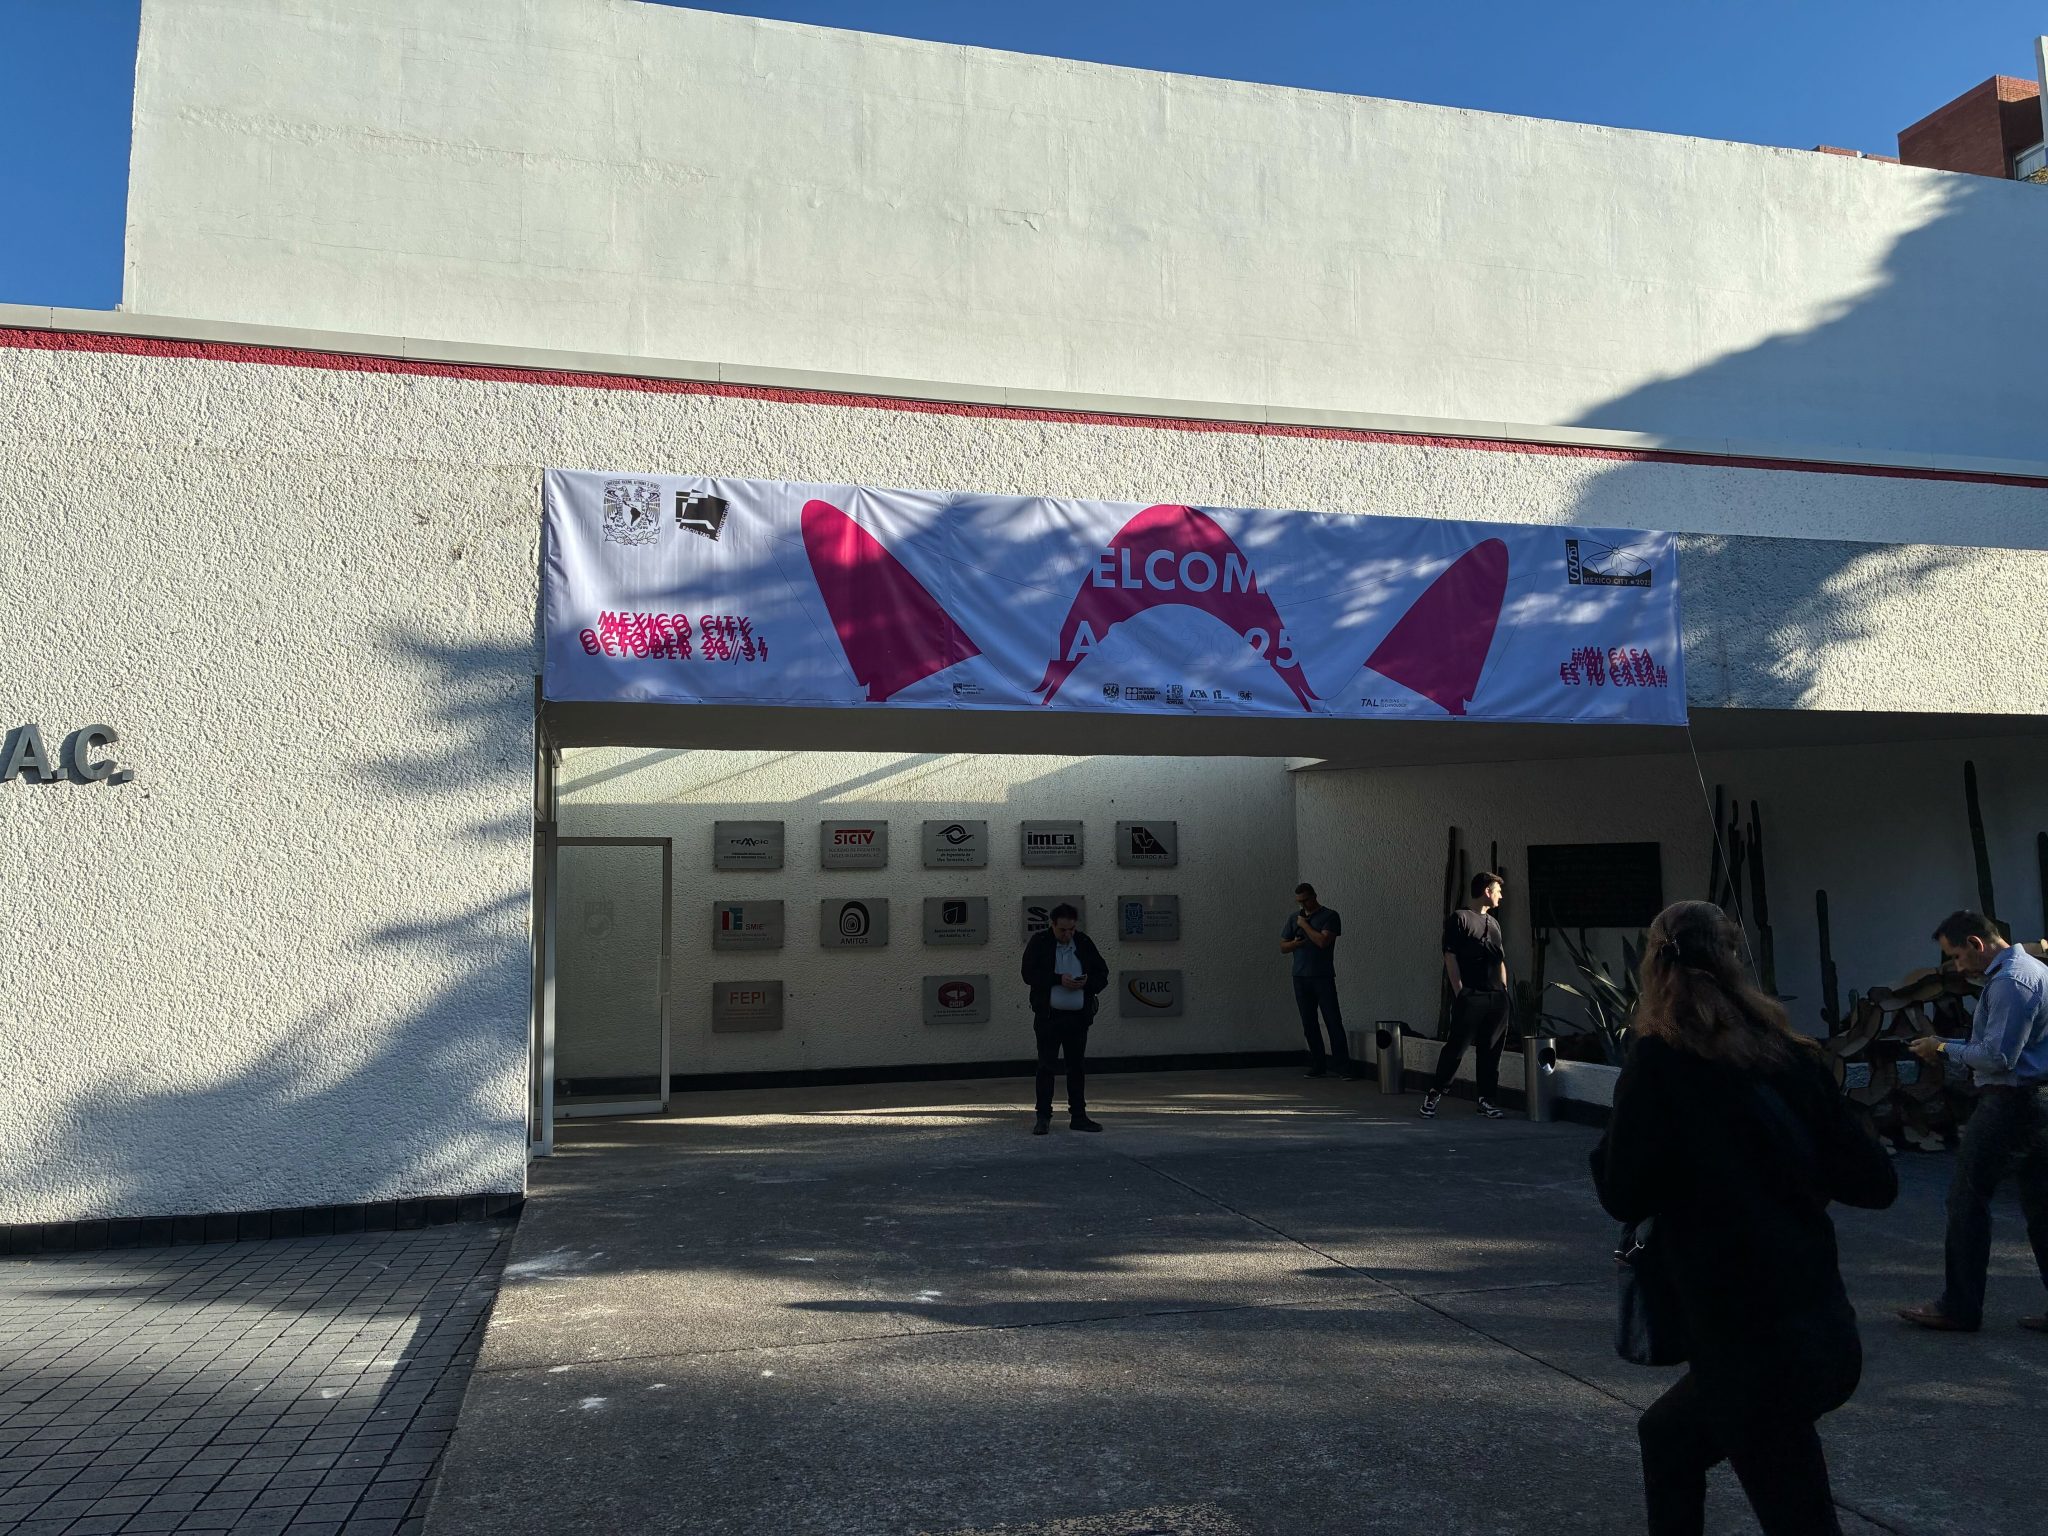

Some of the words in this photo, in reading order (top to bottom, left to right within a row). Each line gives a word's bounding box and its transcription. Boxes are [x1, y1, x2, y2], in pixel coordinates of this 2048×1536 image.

[1058, 547, 1288, 596] ELCOM
[1583, 577, 1612, 585] MEXICO
[5, 724, 134, 781] A.C.
[834, 831, 875, 845] SICIV
[1027, 832, 1076, 845] imca
[1138, 981, 1172, 993] PIARC
[730, 991, 766, 1004] FEPI
